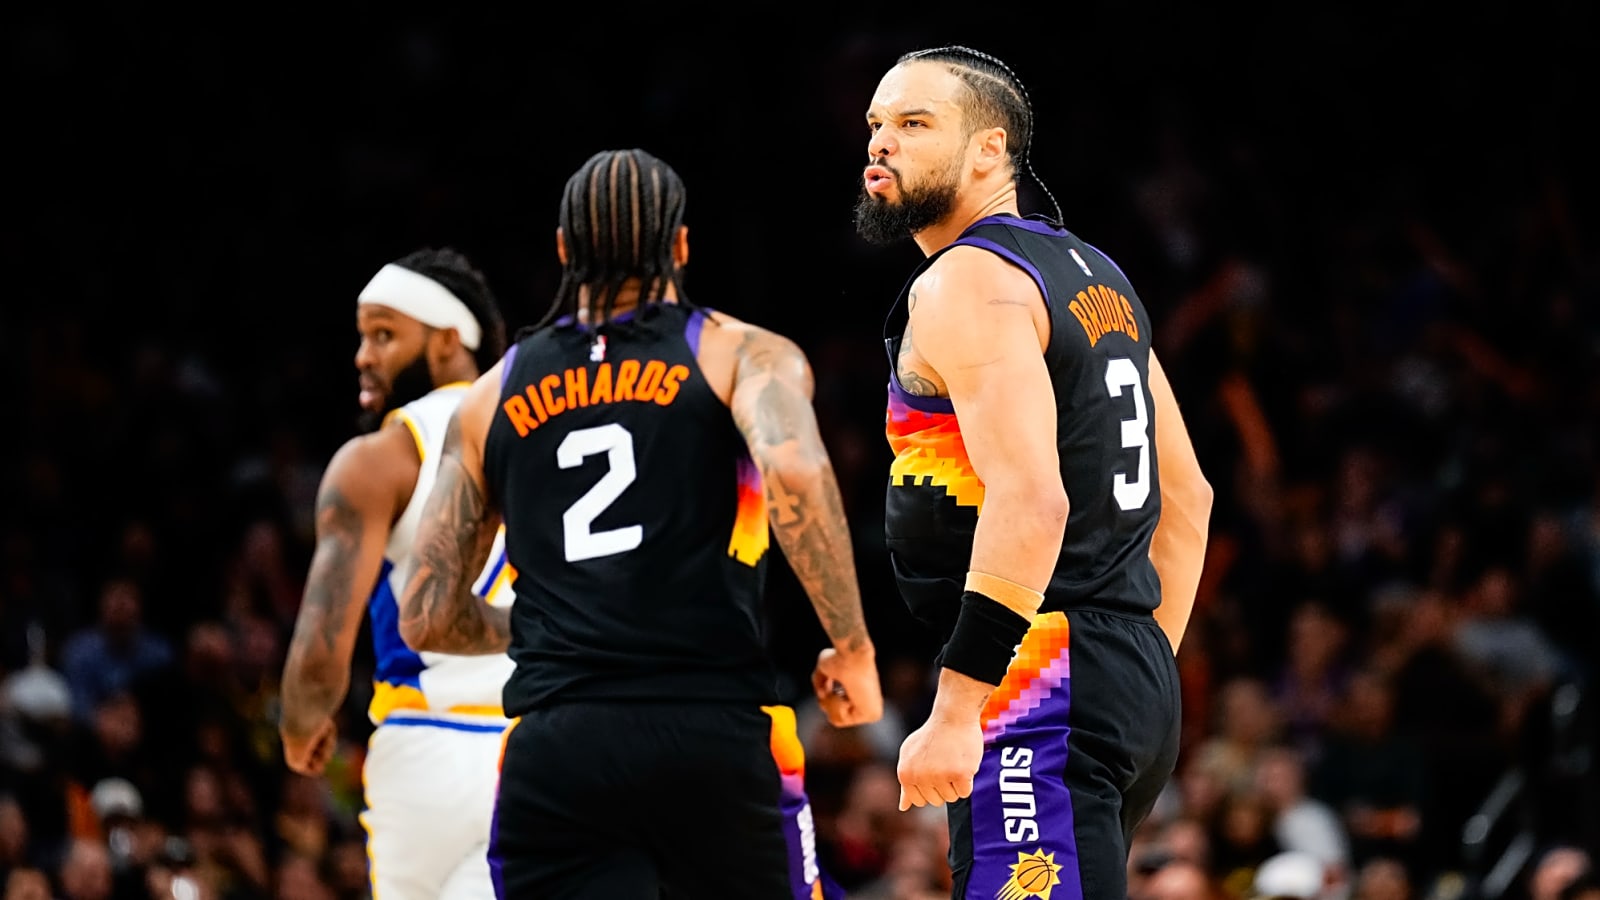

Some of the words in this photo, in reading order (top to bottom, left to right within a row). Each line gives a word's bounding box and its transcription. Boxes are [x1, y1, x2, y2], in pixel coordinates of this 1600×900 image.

[1067, 284, 1139, 348] BROOKS
[503, 359, 690, 438] RICHARDS
[1104, 358, 1150, 511] 3
[556, 423, 643, 562] 2
[1000, 746, 1039, 842] SUNS
